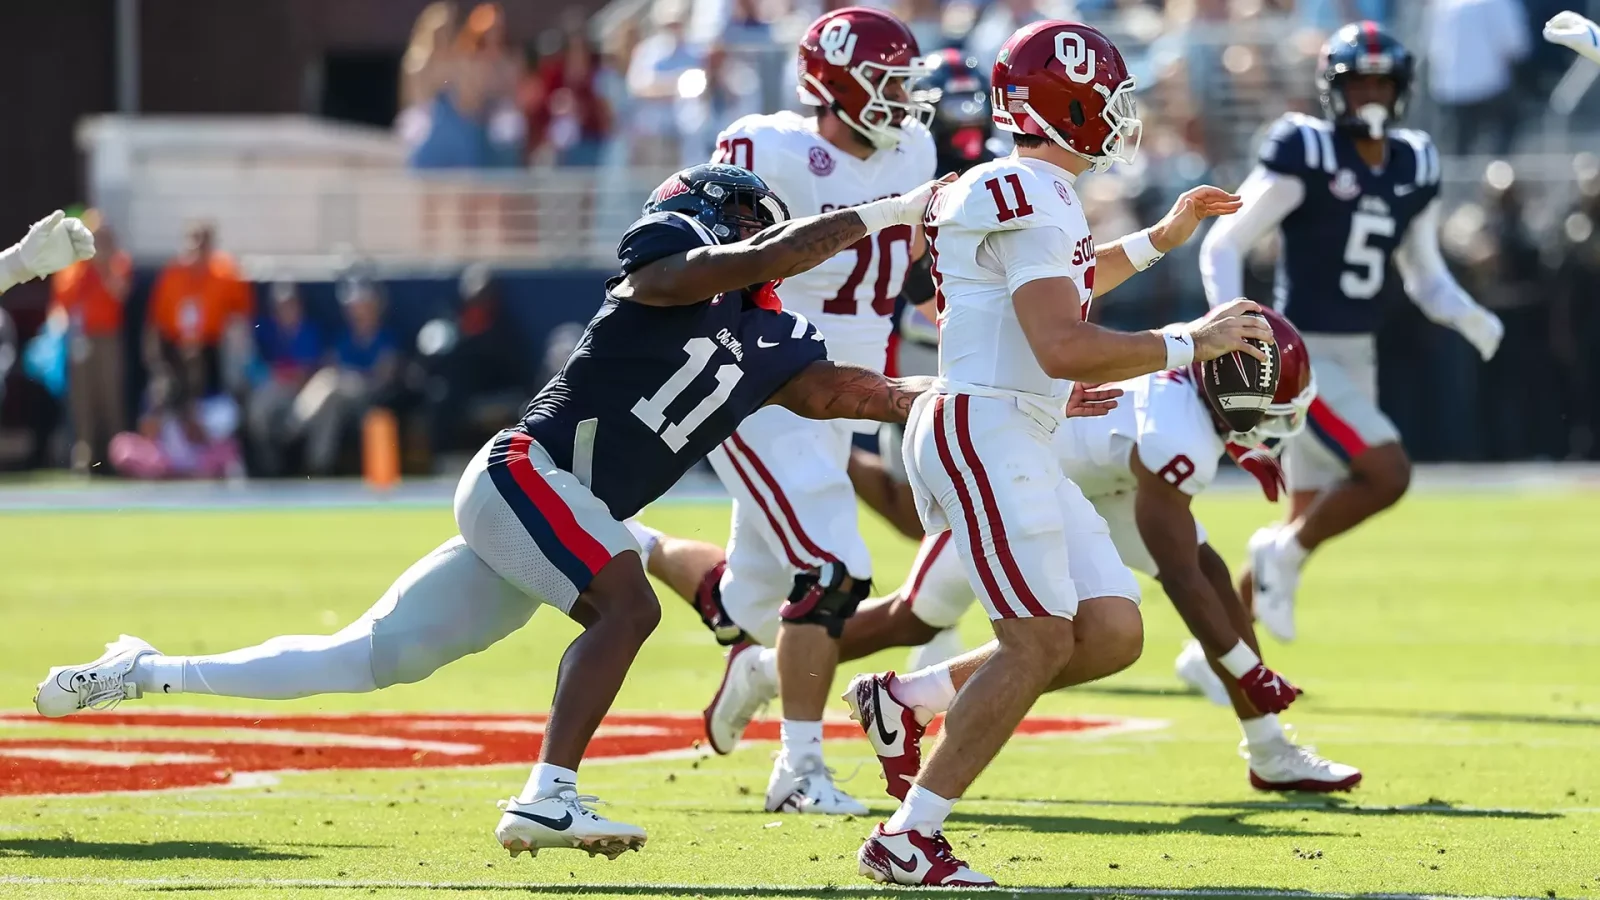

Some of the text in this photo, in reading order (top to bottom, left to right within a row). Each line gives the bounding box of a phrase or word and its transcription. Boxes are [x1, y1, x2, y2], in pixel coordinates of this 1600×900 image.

[819, 18, 858, 66] OU
[1054, 31, 1096, 84] OU
[985, 173, 1034, 223] 11
[823, 224, 911, 316] 70
[1340, 211, 1396, 300] 5
[716, 328, 744, 362] Ole Miss
[631, 337, 744, 454] 11
[1159, 454, 1195, 486] 8
